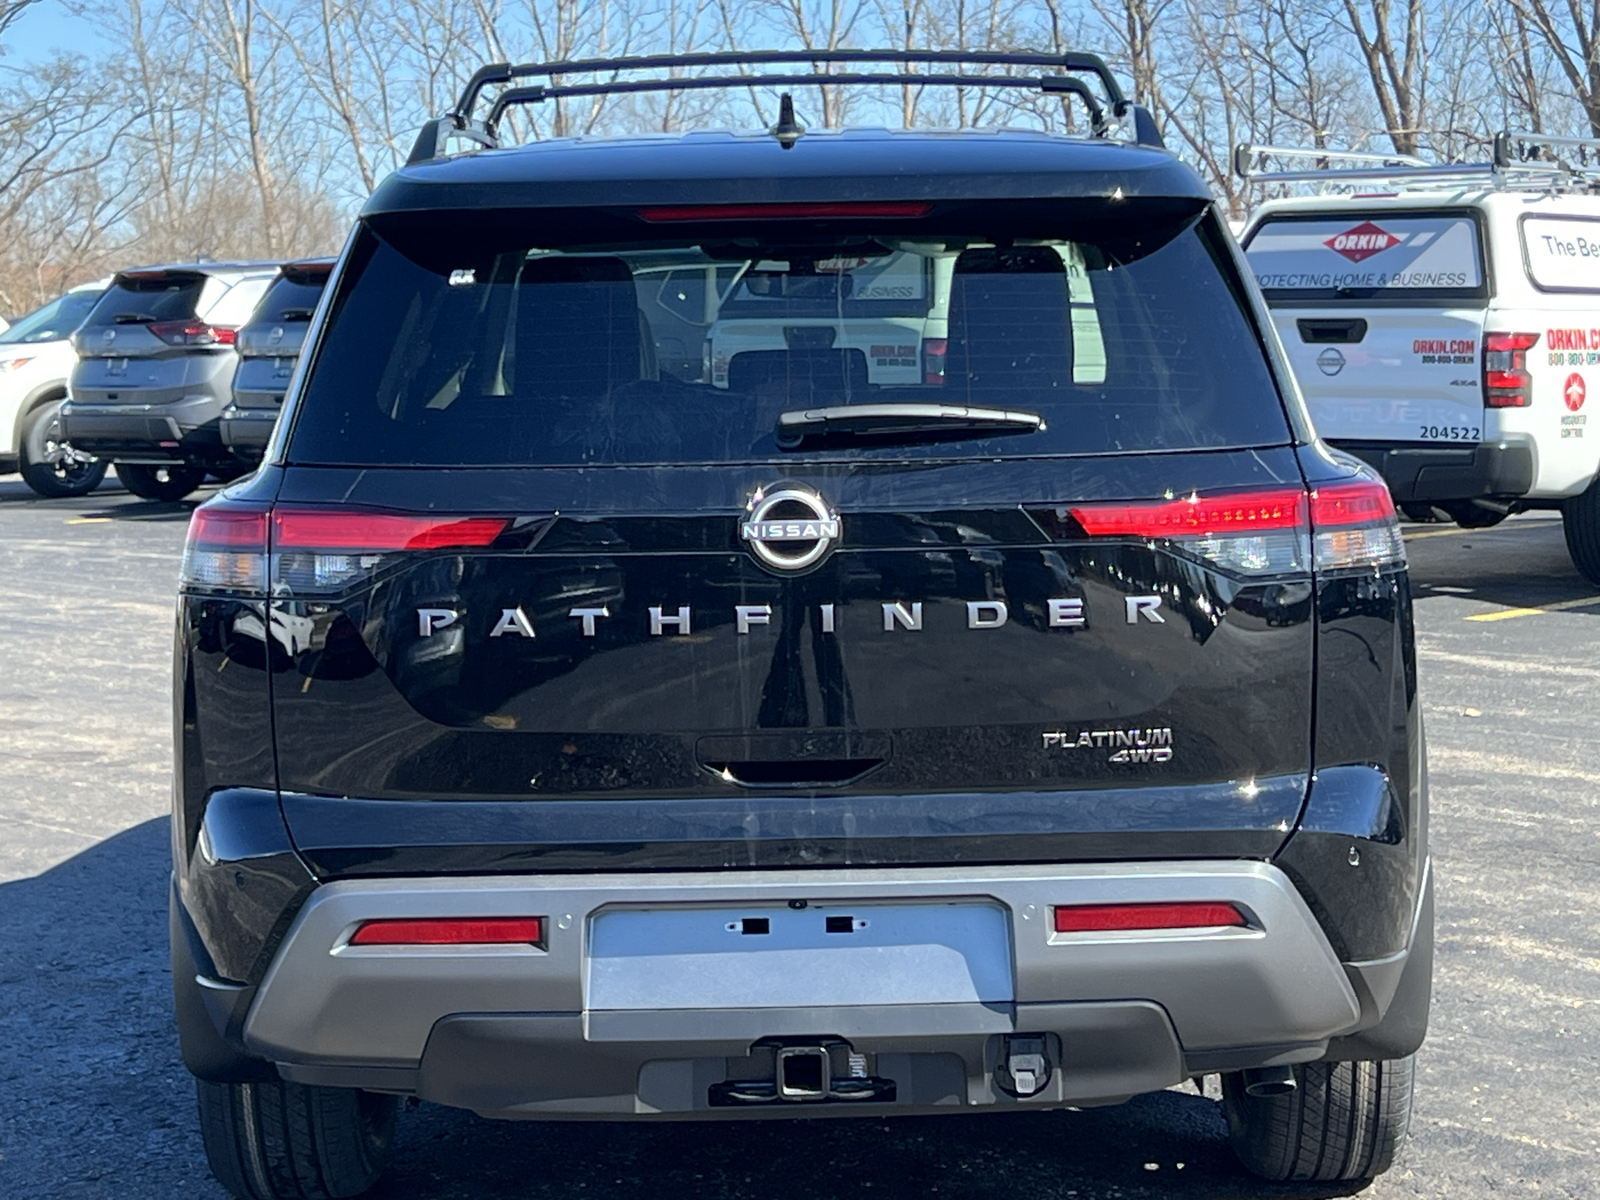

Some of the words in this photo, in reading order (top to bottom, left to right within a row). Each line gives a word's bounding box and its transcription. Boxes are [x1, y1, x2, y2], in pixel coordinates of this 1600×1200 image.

[1334, 234, 1388, 250] ORKIN
[1541, 235, 1576, 257] The
[1576, 236, 1600, 258] Be
[1254, 273, 1331, 287] OTECTING
[1333, 273, 1375, 287] HOME
[1377, 273, 1388, 286] &
[1391, 272, 1467, 286] BUSINESS
[856, 286, 914, 298] BUSINESS
[1413, 339, 1475, 354] ORKIN.COM
[1547, 328, 1600, 350] ORKIN.C
[1420, 425, 1481, 440] 204522
[743, 523, 835, 538] NISSAN
[416, 594, 1166, 638] PATHFINDER
[1042, 727, 1174, 749] PLATINUM
[1108, 747, 1174, 763] 4WD
